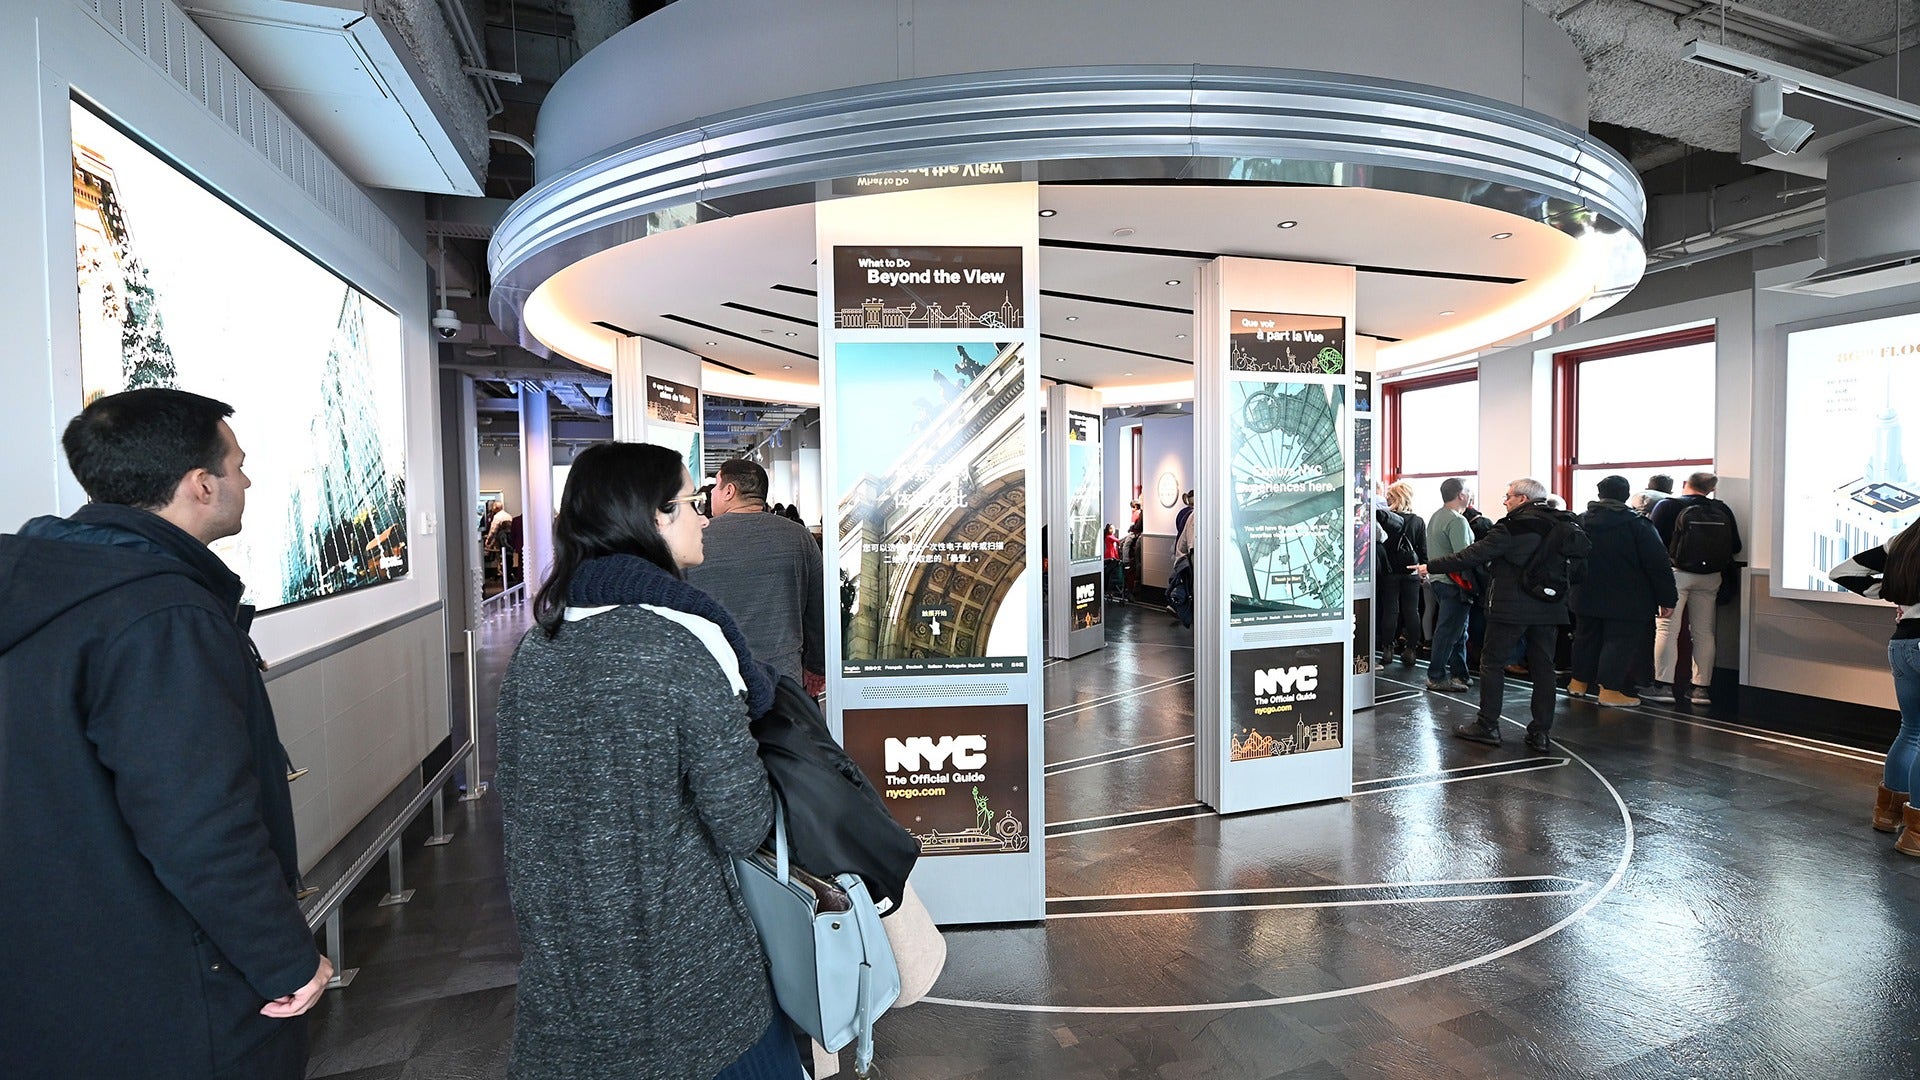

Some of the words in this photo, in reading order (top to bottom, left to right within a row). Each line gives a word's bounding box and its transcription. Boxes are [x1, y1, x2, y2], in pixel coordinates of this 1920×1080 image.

[858, 258, 884, 268] What
[885, 259, 895, 268] to
[896, 258, 911, 268] Do
[867, 269, 931, 287] Beyond
[933, 269, 961, 284] the
[963, 269, 1006, 284] View
[1242, 318, 1258, 328] Que
[1259, 320, 1275, 328] voir
[1256, 329, 1265, 341] à
[1266, 331, 1290, 343] part
[1292, 330, 1302, 340] la
[1303, 331, 1325, 343] Vue
[1309, 481, 1336, 492] here.
[1254, 665, 1318, 696] NYC
[1254, 697, 1269, 706] The
[1270, 694, 1295, 704] Official
[1296, 692, 1317, 701] Guide
[1254, 704, 1293, 715] nycgo.com
[884, 734, 987, 773] NYC
[885, 775, 907, 786] The
[909, 773, 949, 784] Official
[952, 772, 986, 783] Guide
[885, 787, 946, 799] nycgo.com
